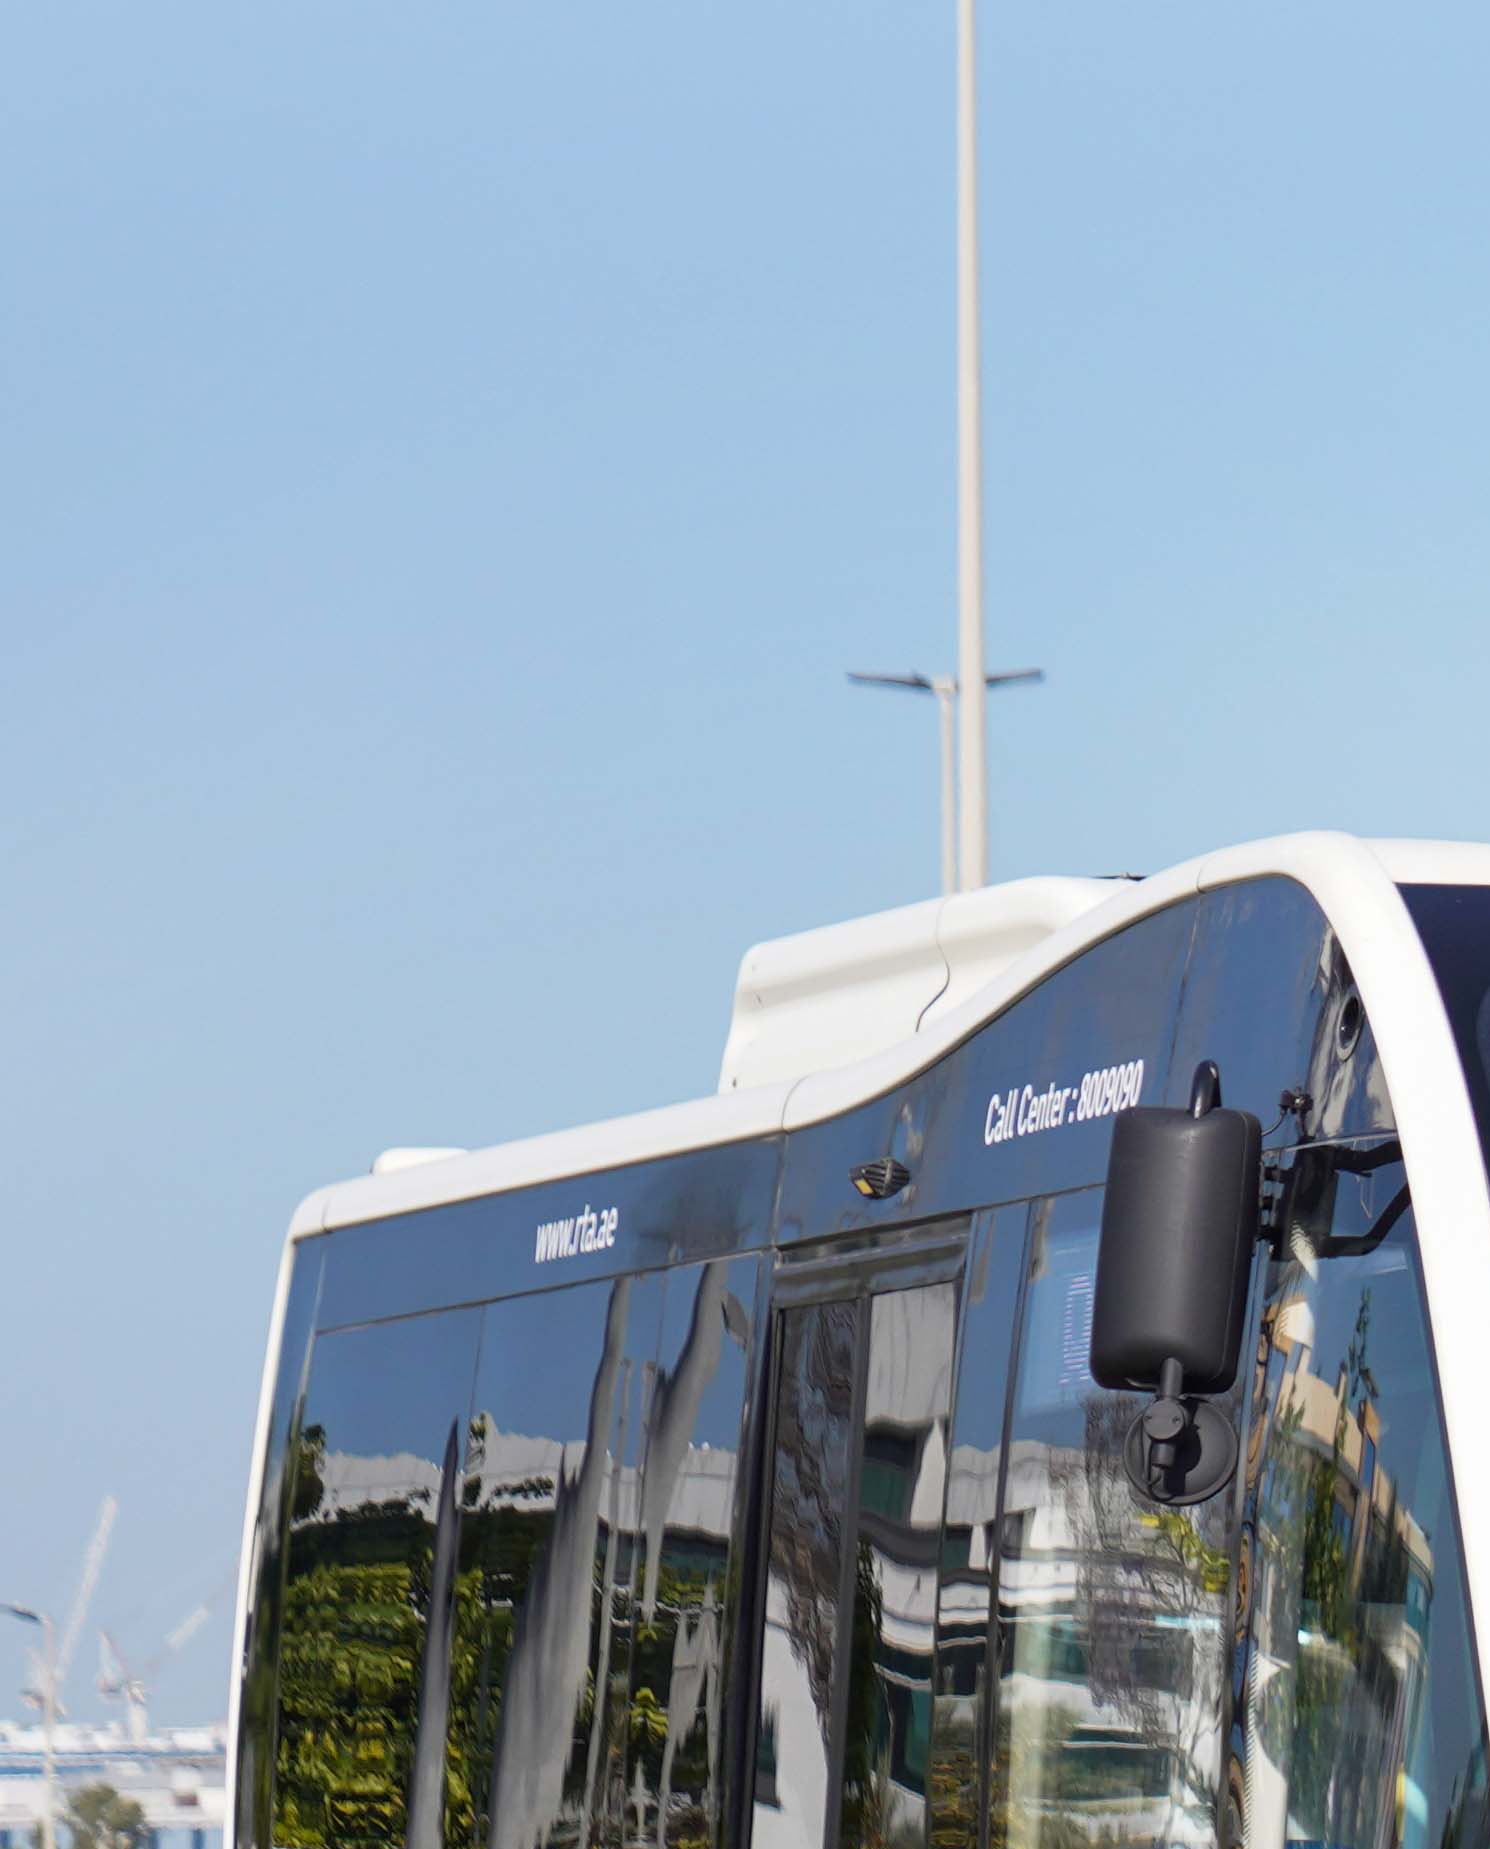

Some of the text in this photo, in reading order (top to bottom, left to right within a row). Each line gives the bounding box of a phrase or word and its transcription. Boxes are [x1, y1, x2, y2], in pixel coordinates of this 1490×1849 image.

[984, 1088, 1019, 1145] Call
[1077, 1059, 1144, 1121] 8009090
[535, 1203, 619, 1264] www.rta.ae
